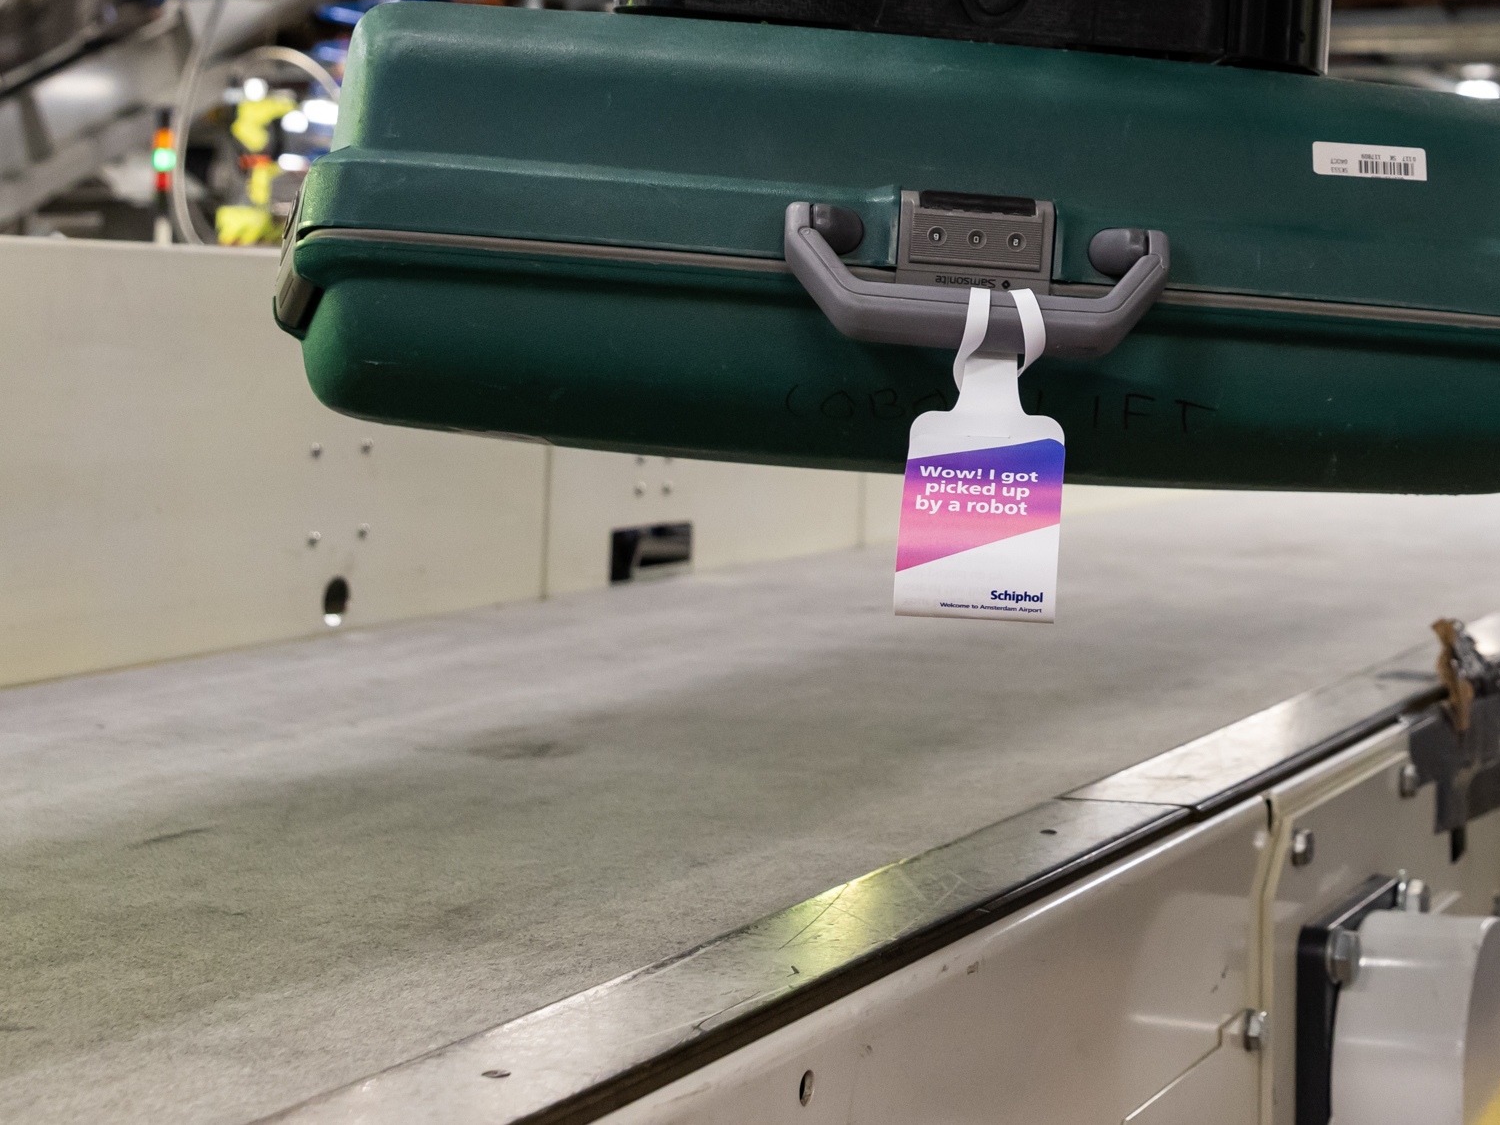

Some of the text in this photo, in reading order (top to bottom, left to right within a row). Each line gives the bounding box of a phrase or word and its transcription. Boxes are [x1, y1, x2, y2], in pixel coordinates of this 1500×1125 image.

[935, 275, 996, 288] Samsonite
[920, 465, 1039, 485] Wow! I got
[925, 480, 1030, 501] picked up
[915, 494, 1028, 515] by a robot
[990, 590, 1044, 604] Schiphol
[939, 601, 971, 610] Welcome
[979, 604, 1018, 612] Amsterdam
[1018, 606, 1043, 614] Airport
